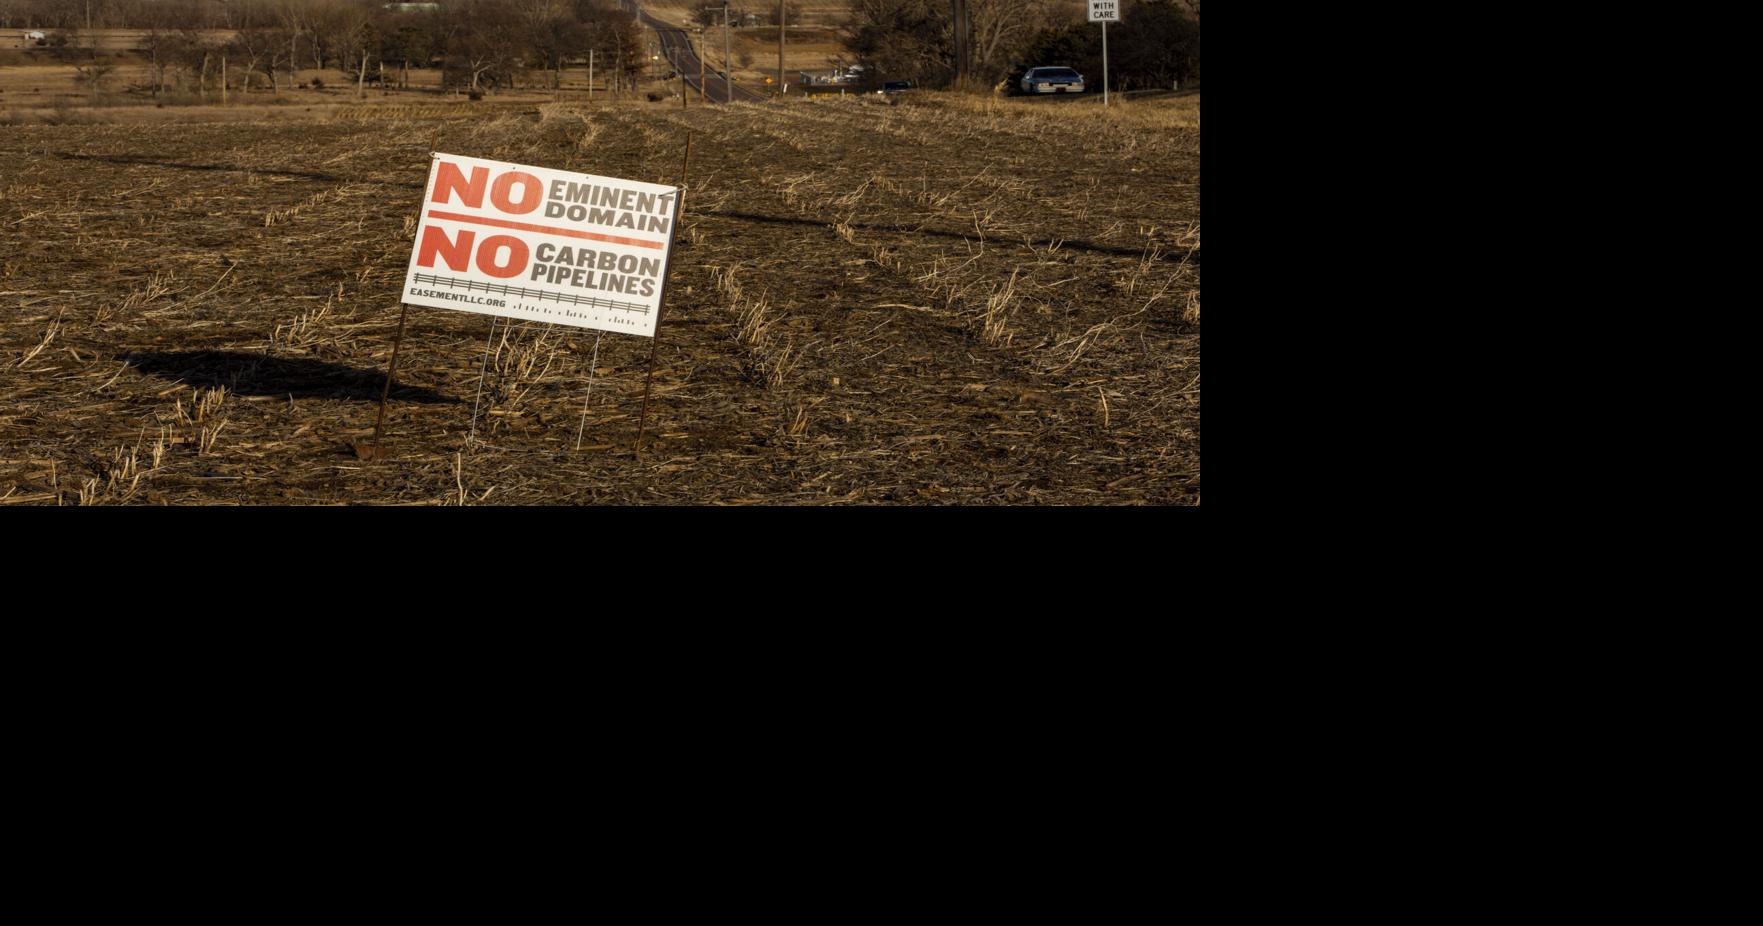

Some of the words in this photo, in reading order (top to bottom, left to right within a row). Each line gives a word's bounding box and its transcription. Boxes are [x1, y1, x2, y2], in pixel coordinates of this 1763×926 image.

[1093, 2, 1114, 10] WITH
[431, 161, 544, 215] NO
[548, 179, 674, 216] EMINENT
[544, 201, 670, 234] DOMAIN
[416, 225, 530, 279] NO
[535, 242, 661, 278] CARBON
[409, 287, 506, 308] EASEMENTLLC.ORG
[530, 263, 656, 298] PIPELINES
